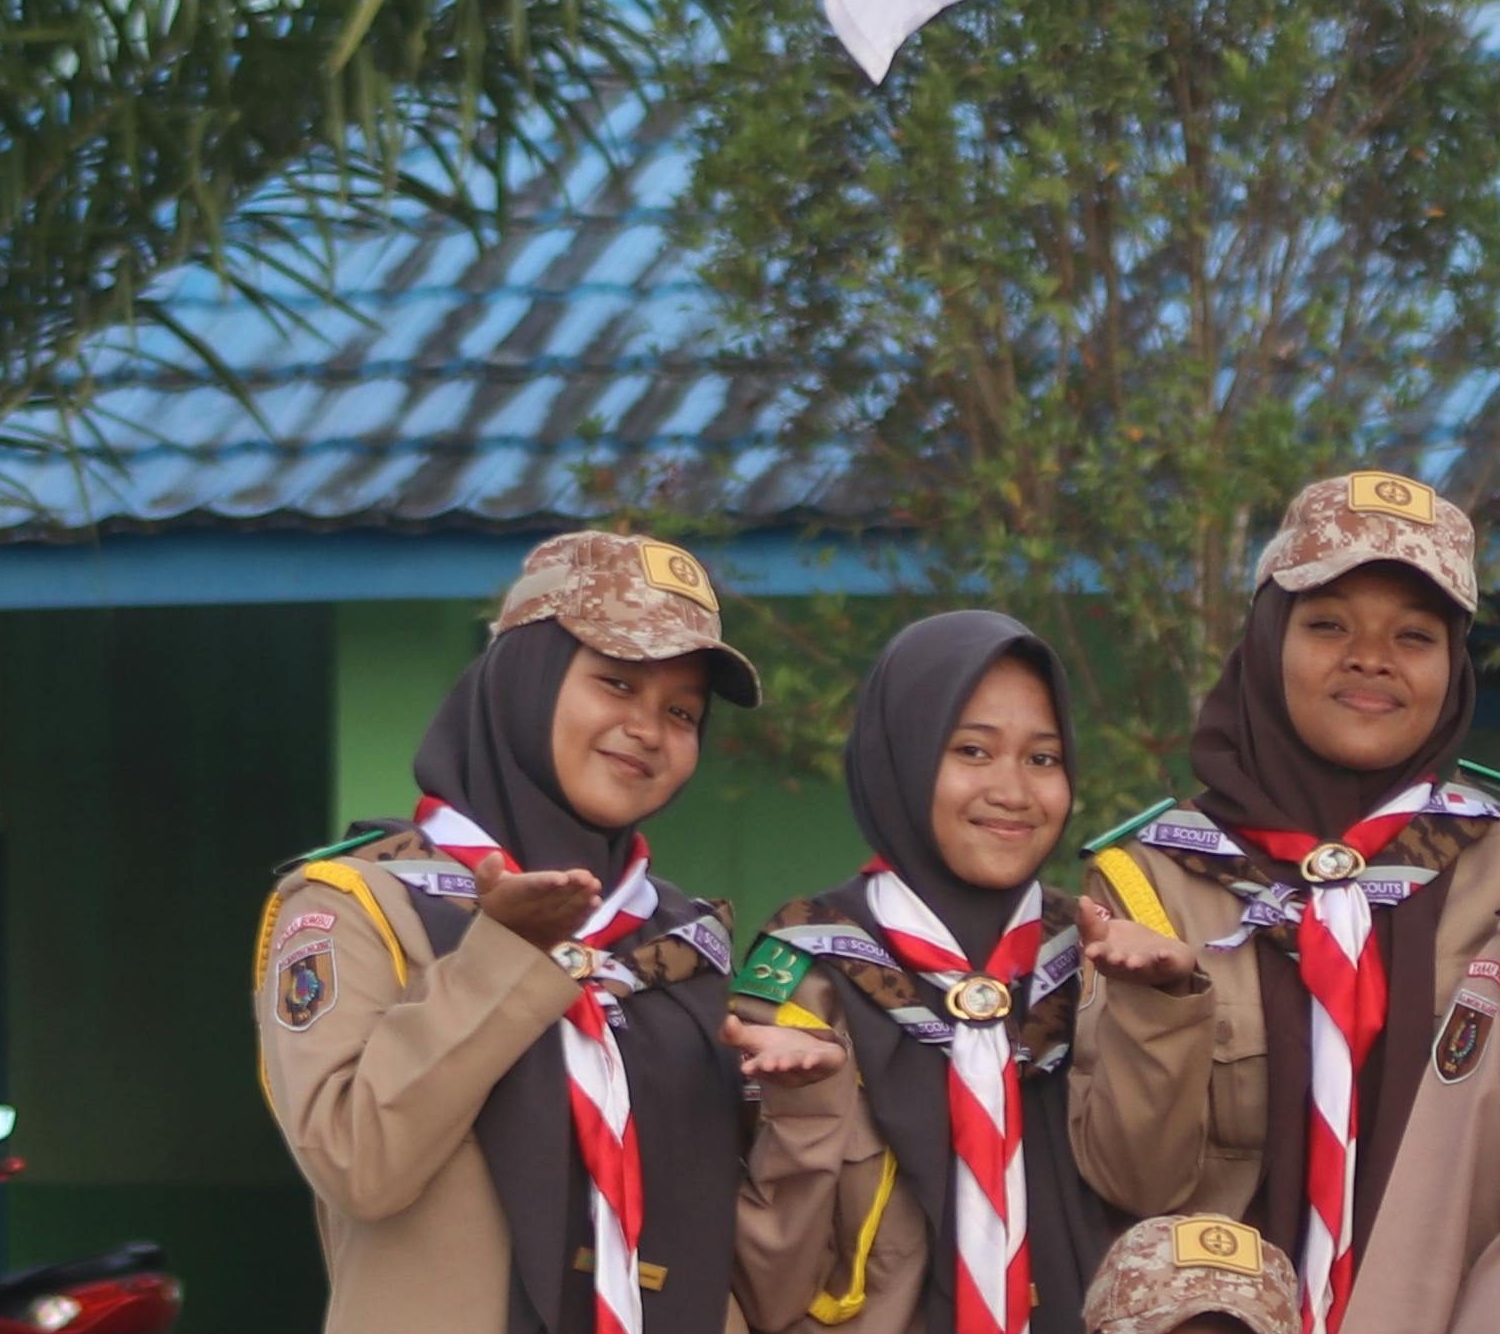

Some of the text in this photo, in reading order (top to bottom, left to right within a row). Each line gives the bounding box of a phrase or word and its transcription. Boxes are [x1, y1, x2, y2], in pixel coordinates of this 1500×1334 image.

[1172, 827, 1219, 843] SCOUTS
[1361, 882, 1402, 895] COUTS
[851, 939, 890, 958] SCOU
[917, 1023, 951, 1034] SCOU
